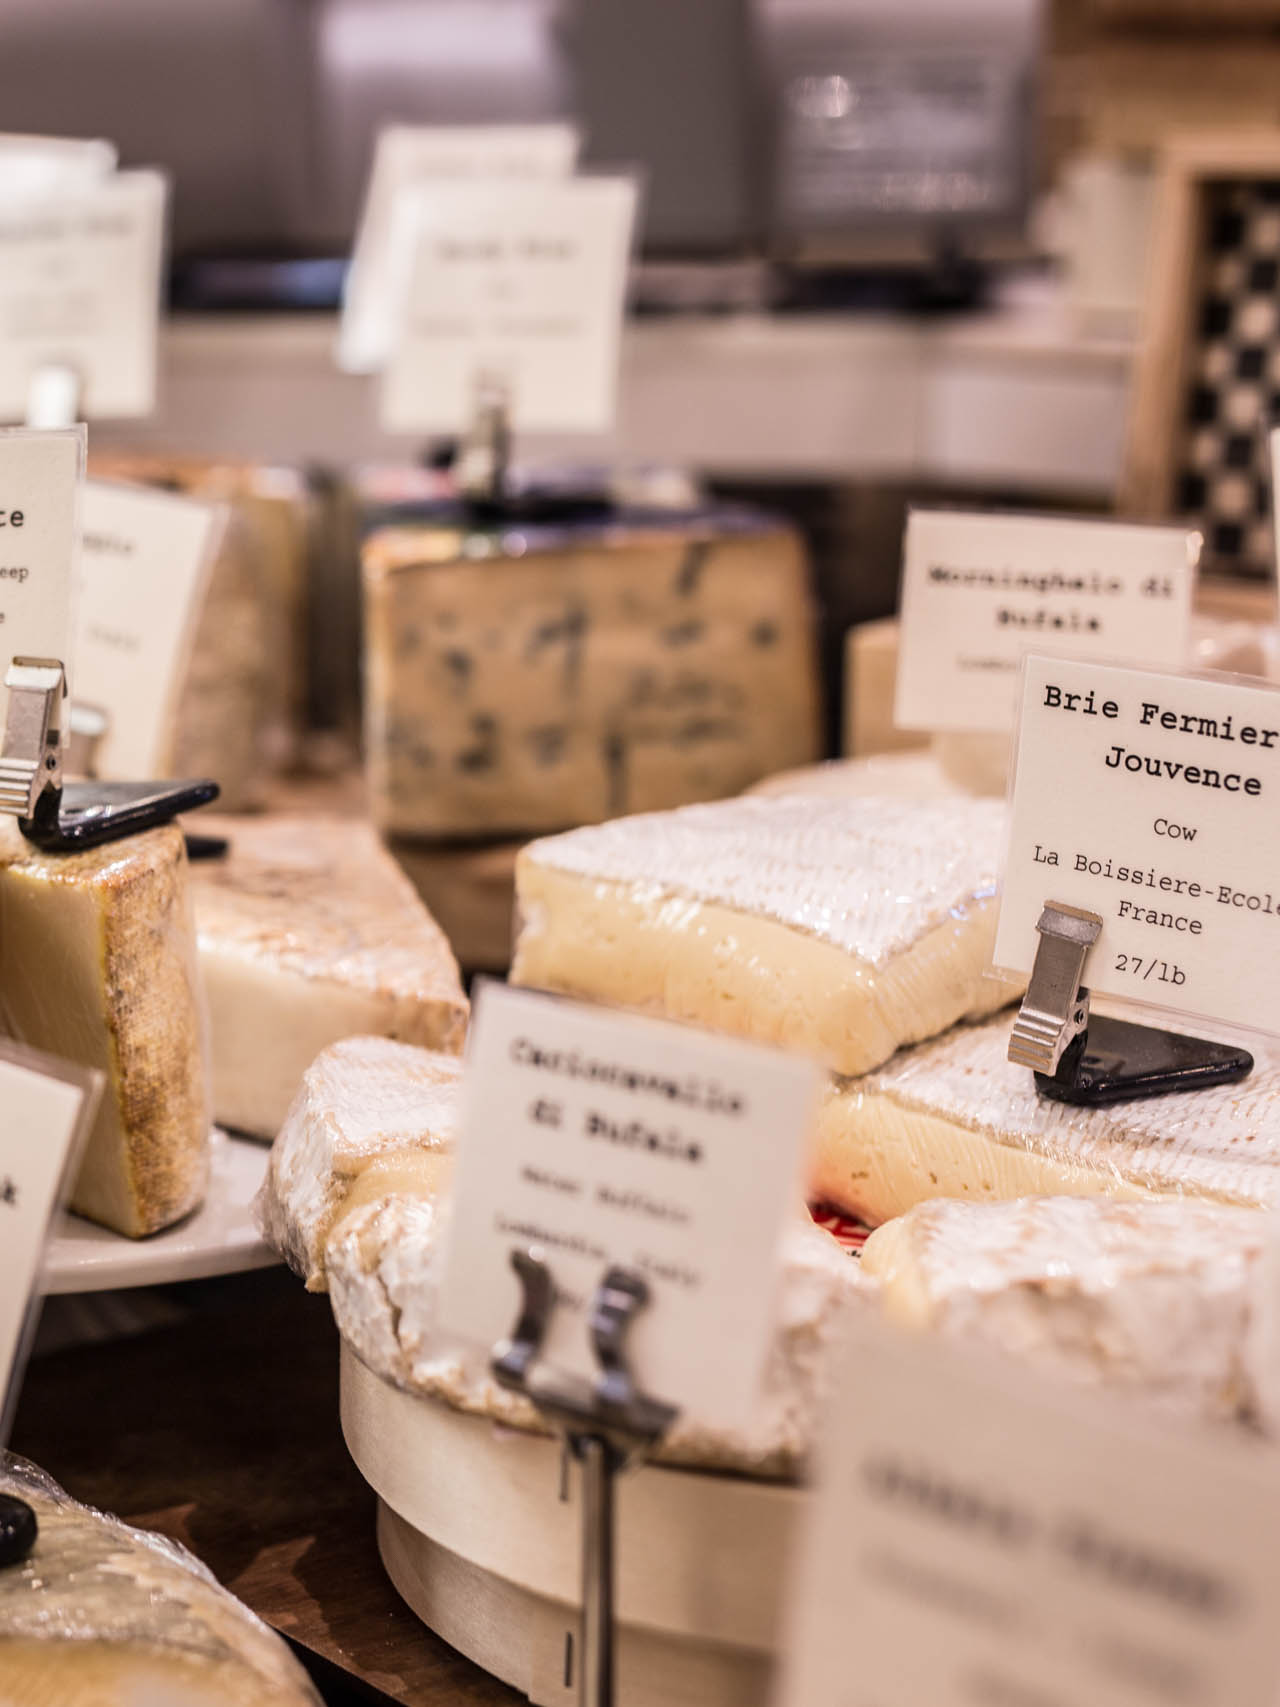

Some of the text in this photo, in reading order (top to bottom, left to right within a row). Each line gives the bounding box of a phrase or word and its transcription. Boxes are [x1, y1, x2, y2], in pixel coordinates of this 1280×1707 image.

[1044, 685, 1279, 748] Brie Fermier
[1105, 746, 1263, 796] Jouvence
[1154, 819, 1197, 841] Cow
[1033, 846, 1280, 917] La Boissiere-Ecol
[1118, 901, 1203, 935] France
[1115, 954, 1185, 985] 27/lb
